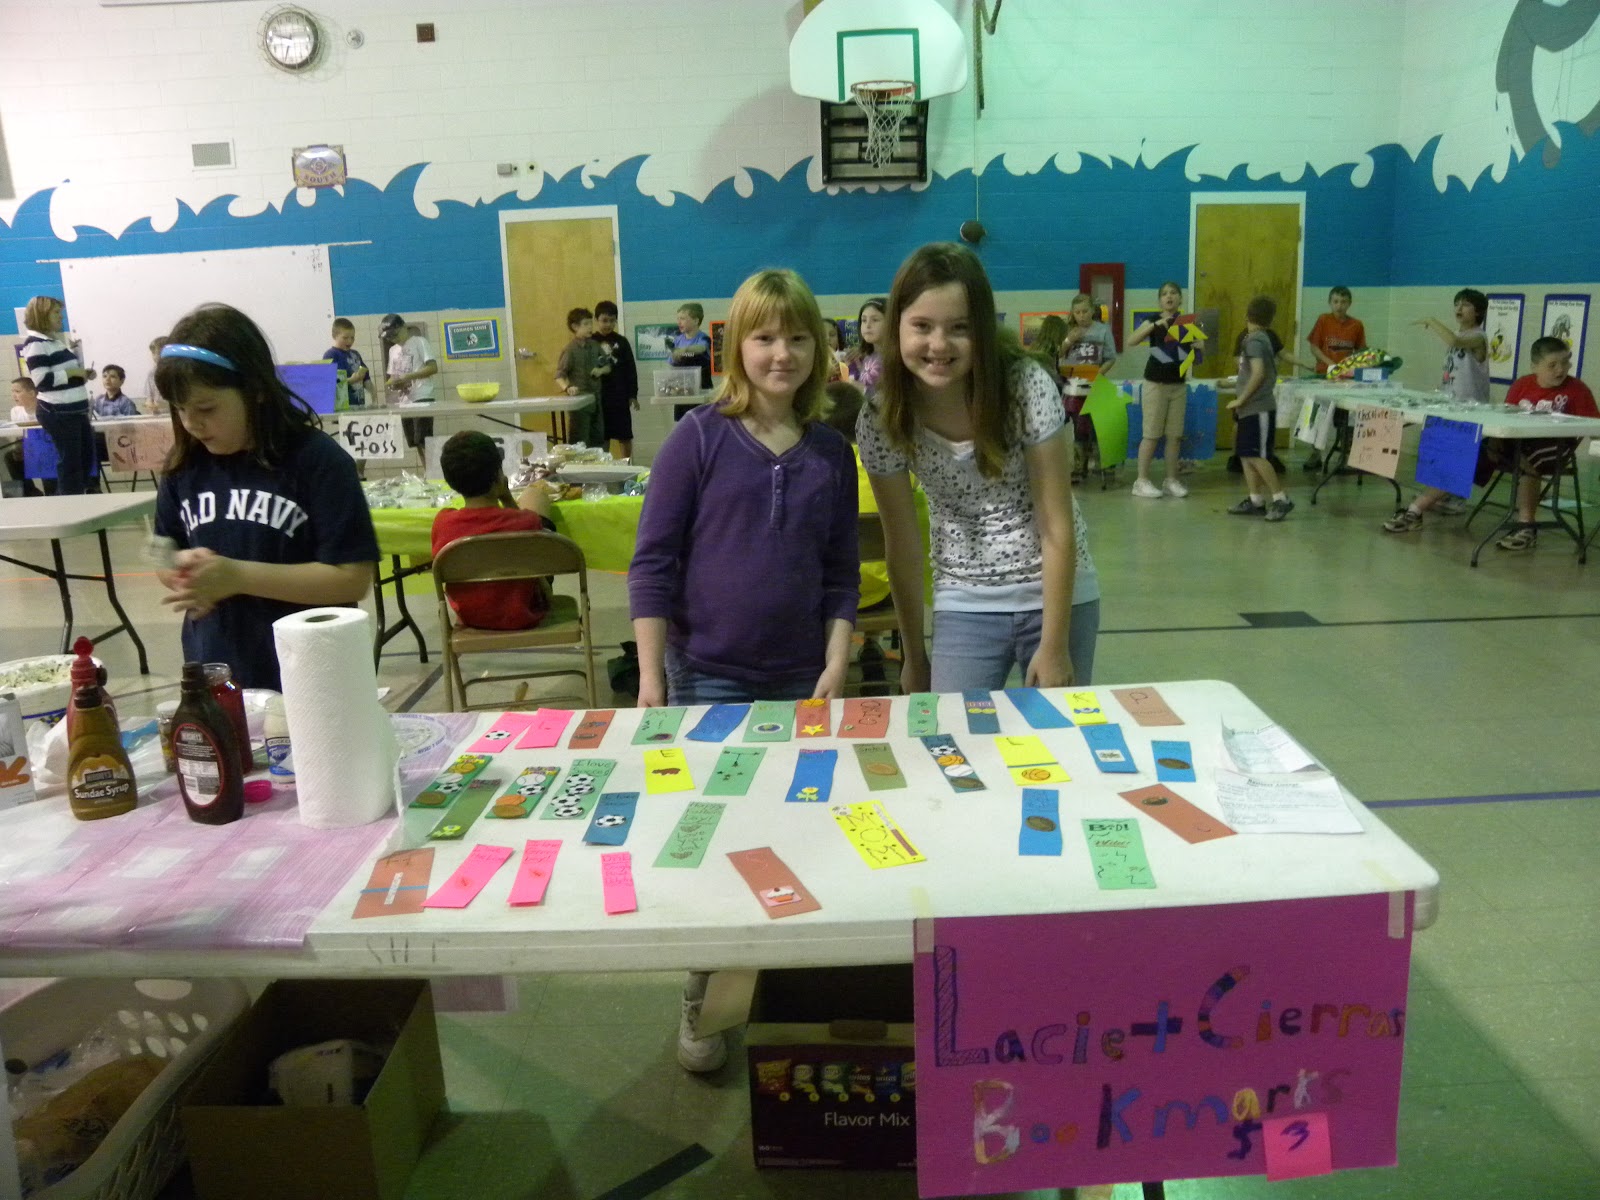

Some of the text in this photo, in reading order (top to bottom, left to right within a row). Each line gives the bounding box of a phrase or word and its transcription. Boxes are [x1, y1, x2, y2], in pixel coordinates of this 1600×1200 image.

[225, 488, 309, 538] NAVY
[74, 783, 130, 799] Sundae Syrup
[933, 945, 1126, 1067] Lacie
[824, 1111, 910, 1127] Flavor Mix
[972, 1067, 1351, 1166] Bookmarks
